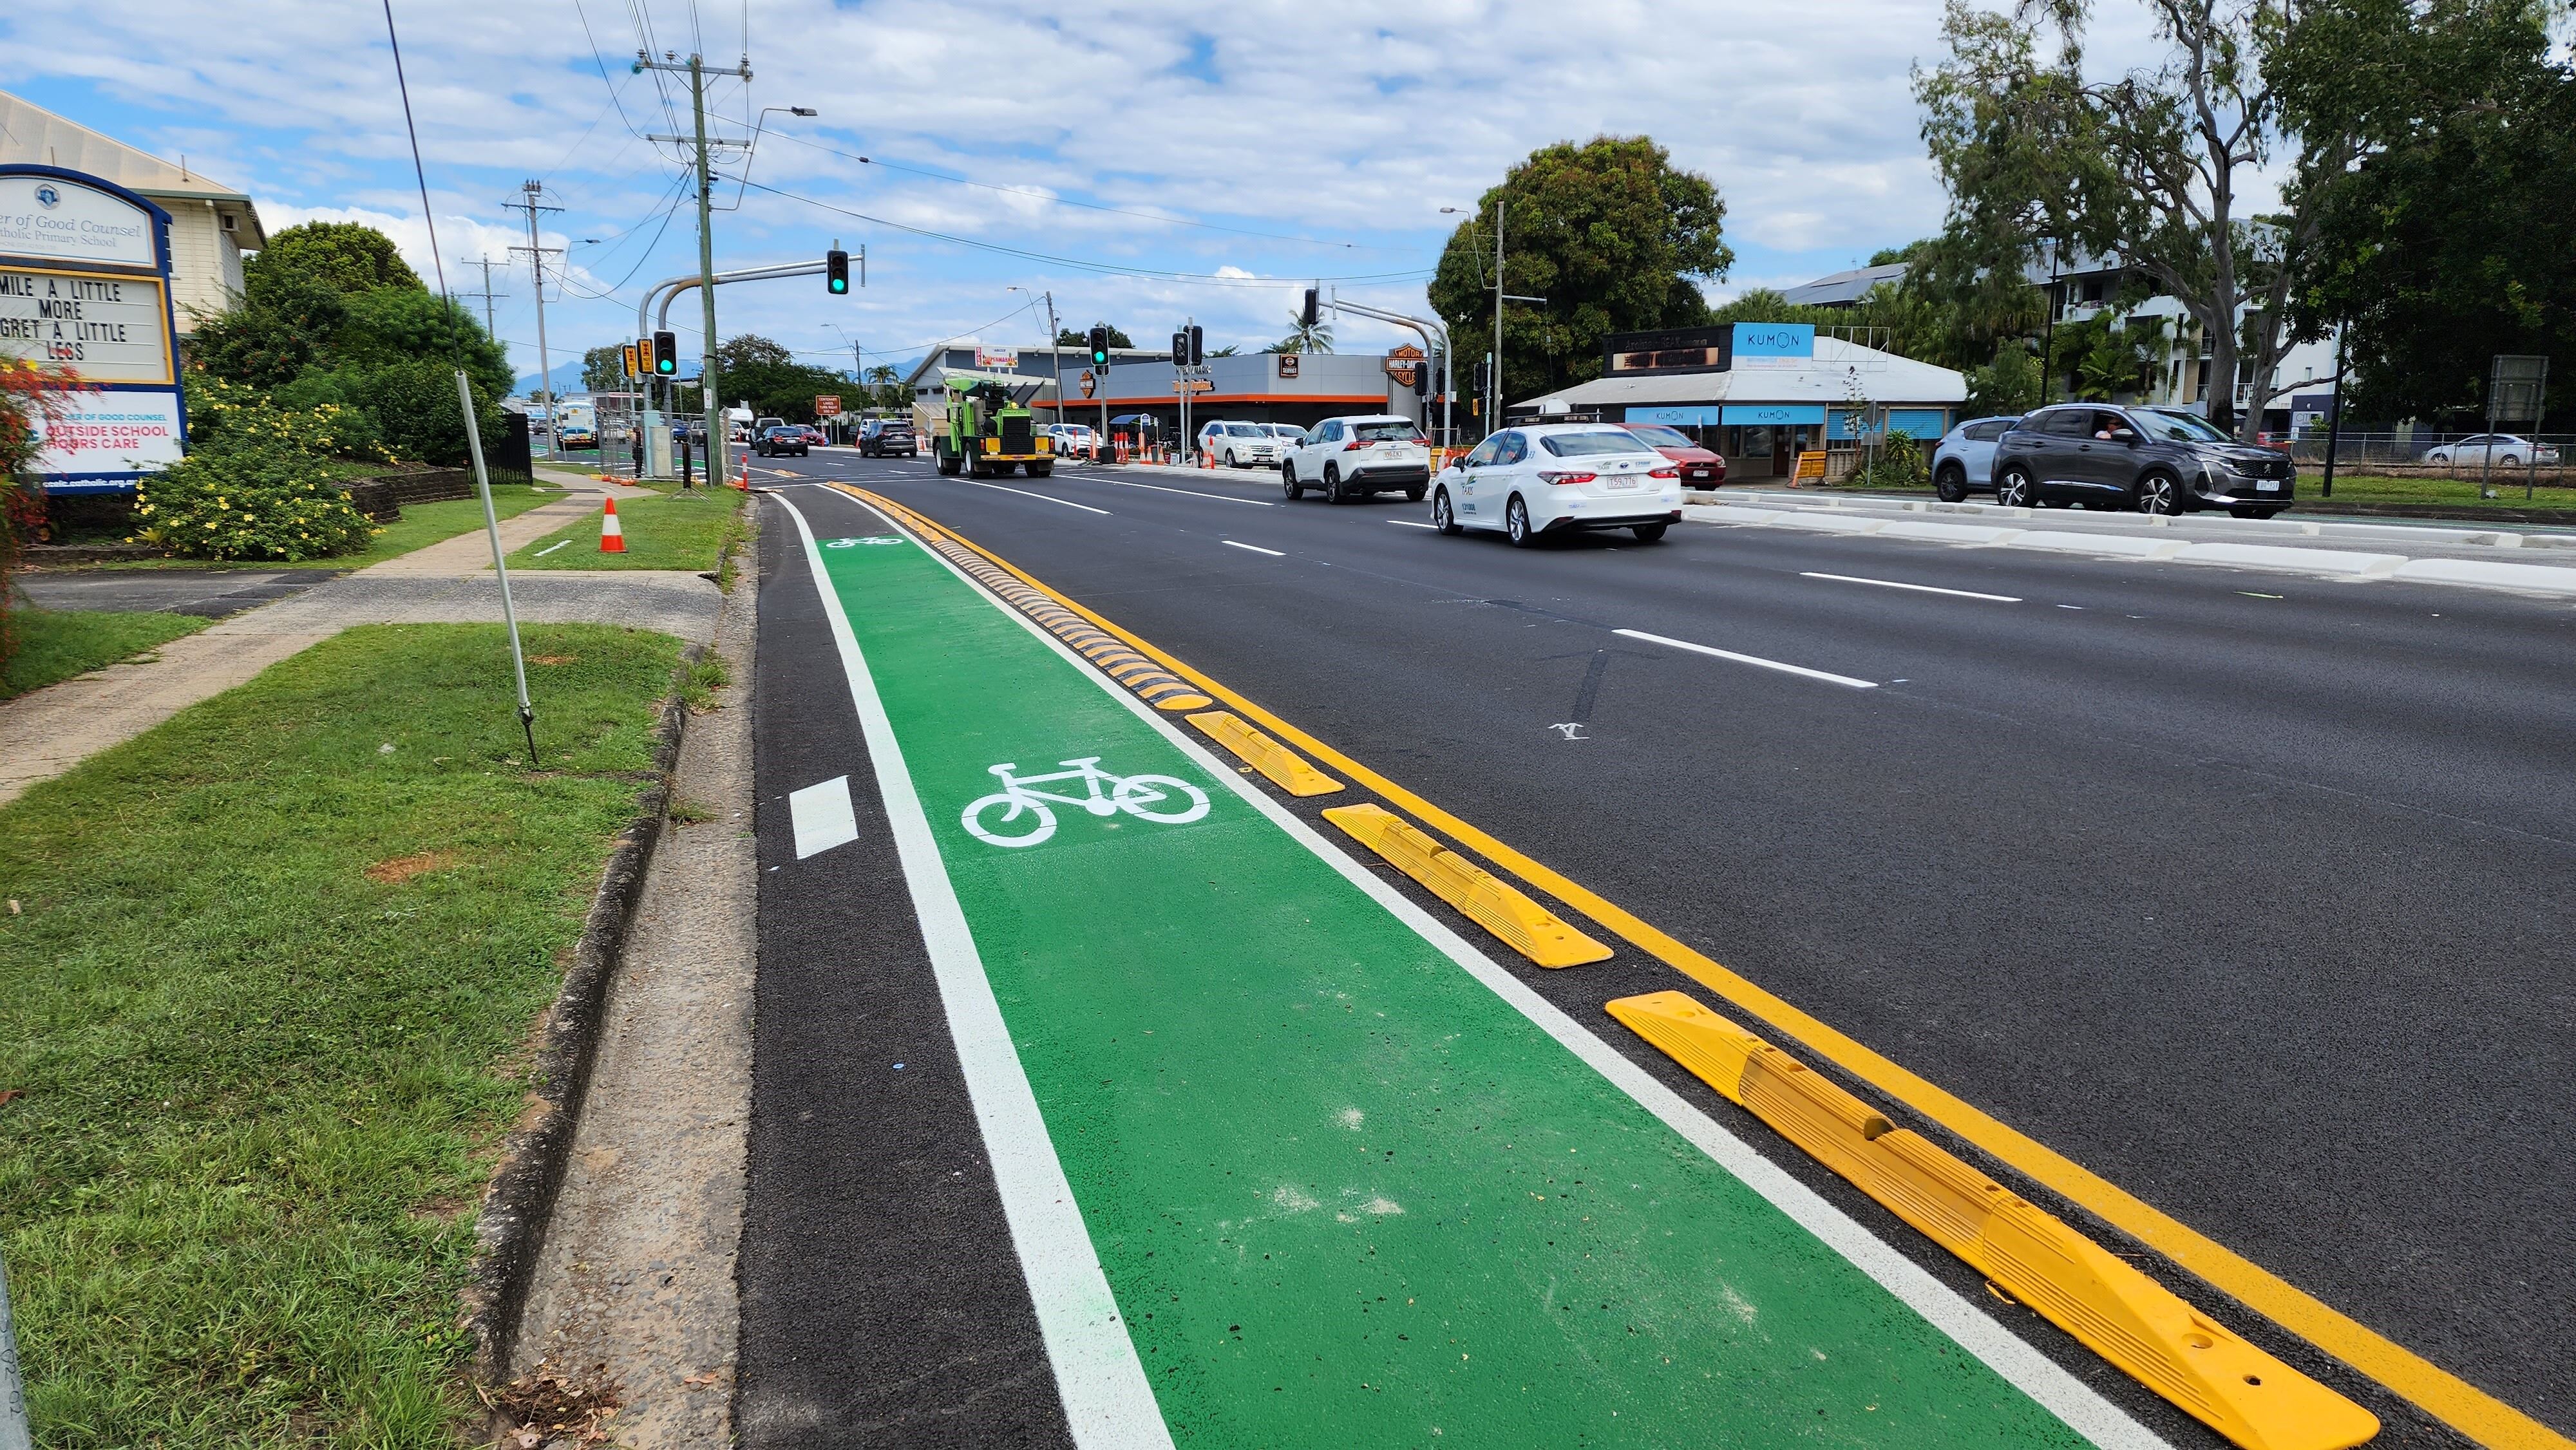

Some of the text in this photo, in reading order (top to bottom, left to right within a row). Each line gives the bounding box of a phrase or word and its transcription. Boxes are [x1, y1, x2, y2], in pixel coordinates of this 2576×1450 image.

[16, 214, 33, 229] of
[36, 216, 75, 231] Good
[81, 220, 141, 238] Counsel
[35, 230, 77, 246] Primary
[81, 235, 117, 248] School
[0, 276, 121, 302] MILE A LITTLE
[39, 299, 82, 320] MORE
[0, 317, 126, 343] GRET A LITTLE
[1748, 332, 1799, 348] KUMON
[46, 341, 84, 361] LESS
[1398, 348, 1421, 357] MOTOR
[1656, 411, 1683, 420] KUMON
[1758, 410, 1790, 420] KUMON
[46, 426, 169, 437] OUTSIDE SCHOOL
[102, 438, 140, 449] CARE
[1462, 486, 1473, 495] TAXIS
